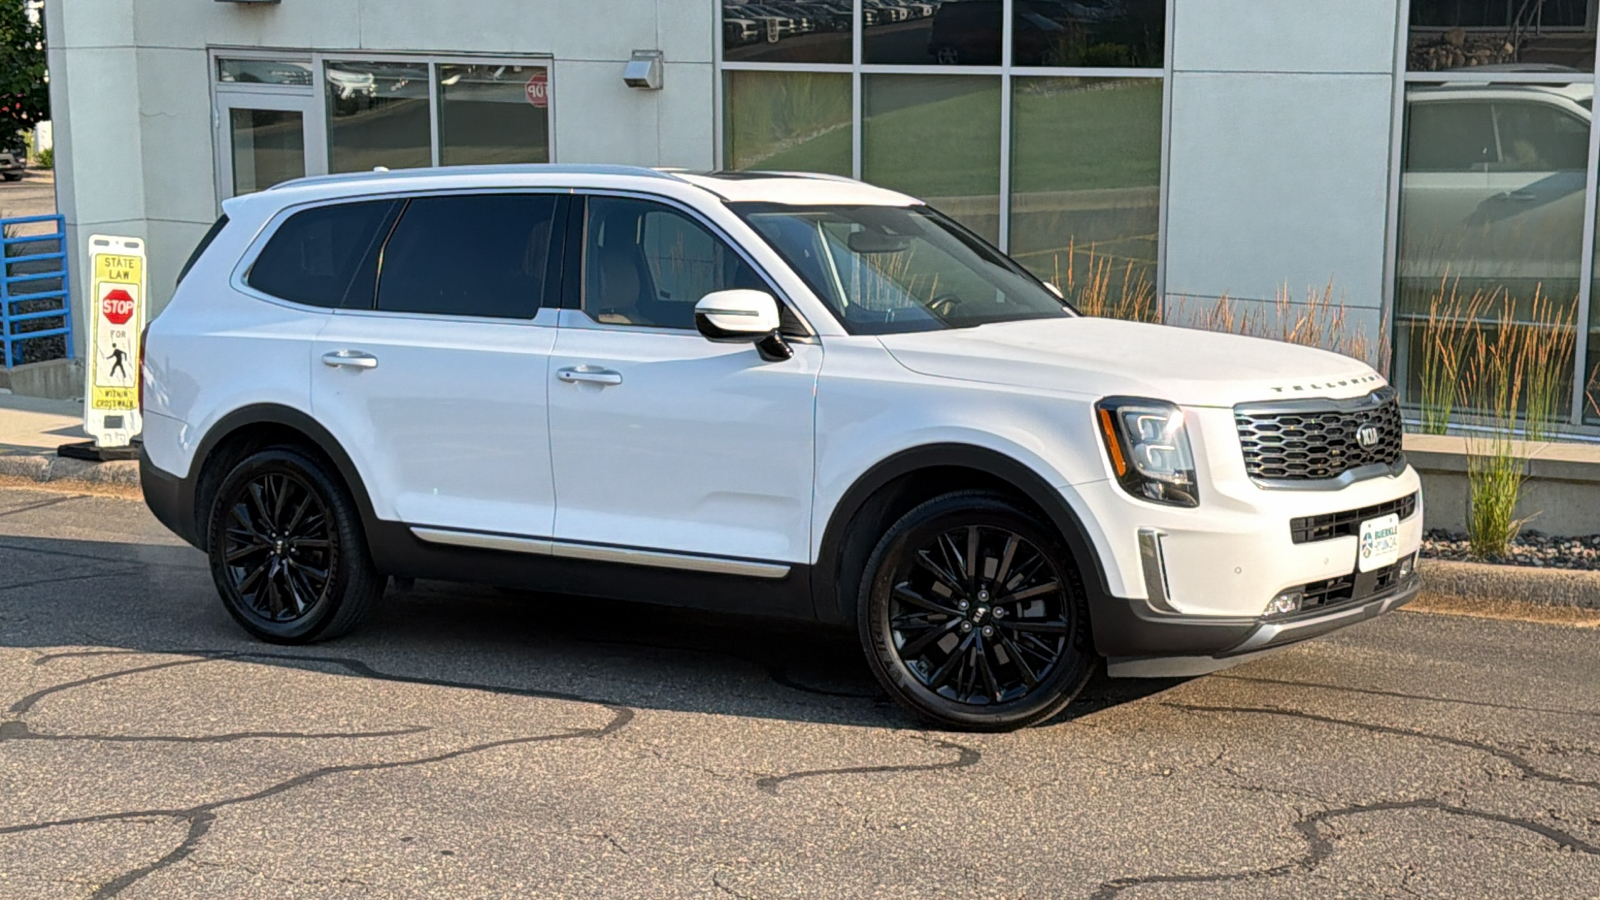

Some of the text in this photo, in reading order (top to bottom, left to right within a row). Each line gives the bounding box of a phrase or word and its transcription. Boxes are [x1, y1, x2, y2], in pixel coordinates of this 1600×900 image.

[104, 257, 135, 269] STATE
[109, 269, 130, 280] LAW
[103, 299, 134, 315] STOP
[110, 330, 126, 338] FOR
[1362, 427, 1378, 446] KIA
